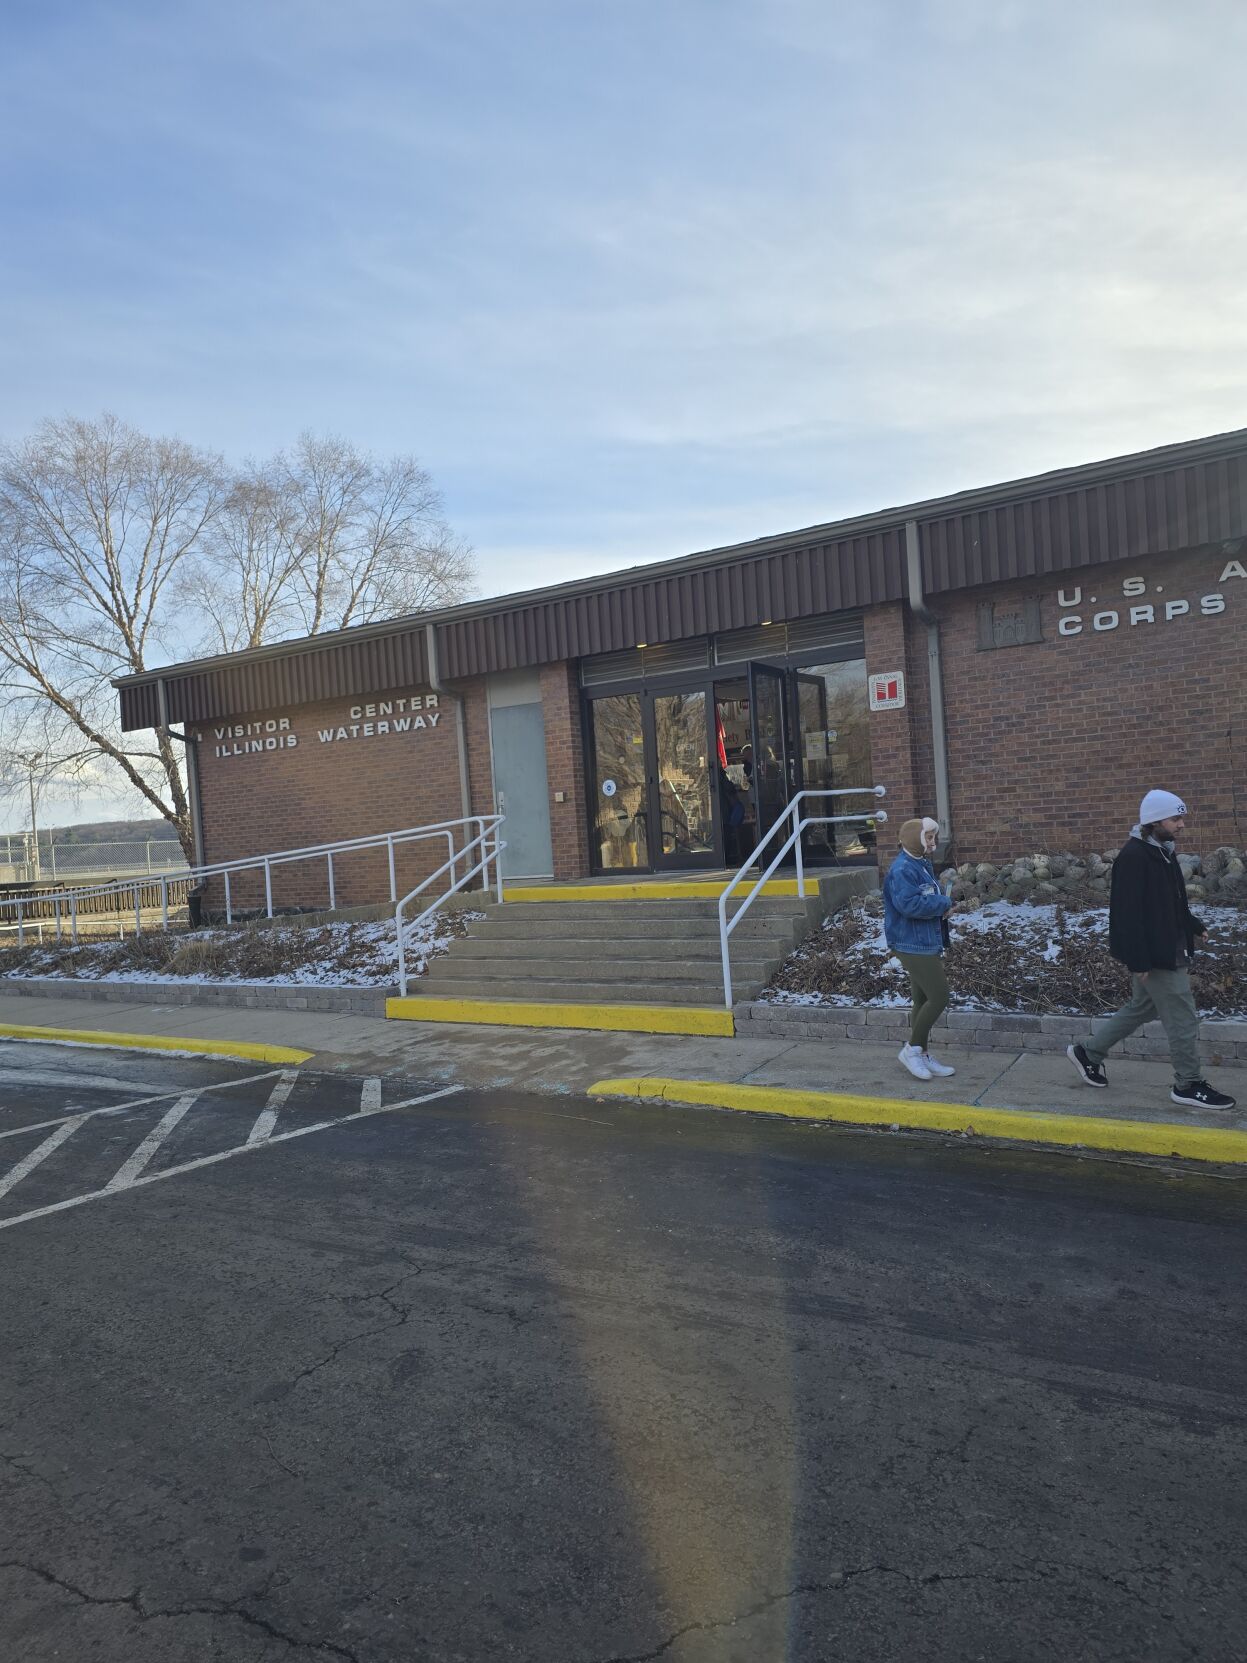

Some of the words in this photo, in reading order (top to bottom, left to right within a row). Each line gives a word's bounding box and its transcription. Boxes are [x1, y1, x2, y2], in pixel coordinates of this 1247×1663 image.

[1057, 586, 1097, 607] U.
[1122, 576, 1163, 597] S.
[1058, 593, 1226, 636] CORPS
[214, 717, 291, 741] VISITOR
[350, 694, 439, 720] CENTER
[215, 734, 298, 758] ILLINOIS
[317, 713, 440, 743] WATERWAY
